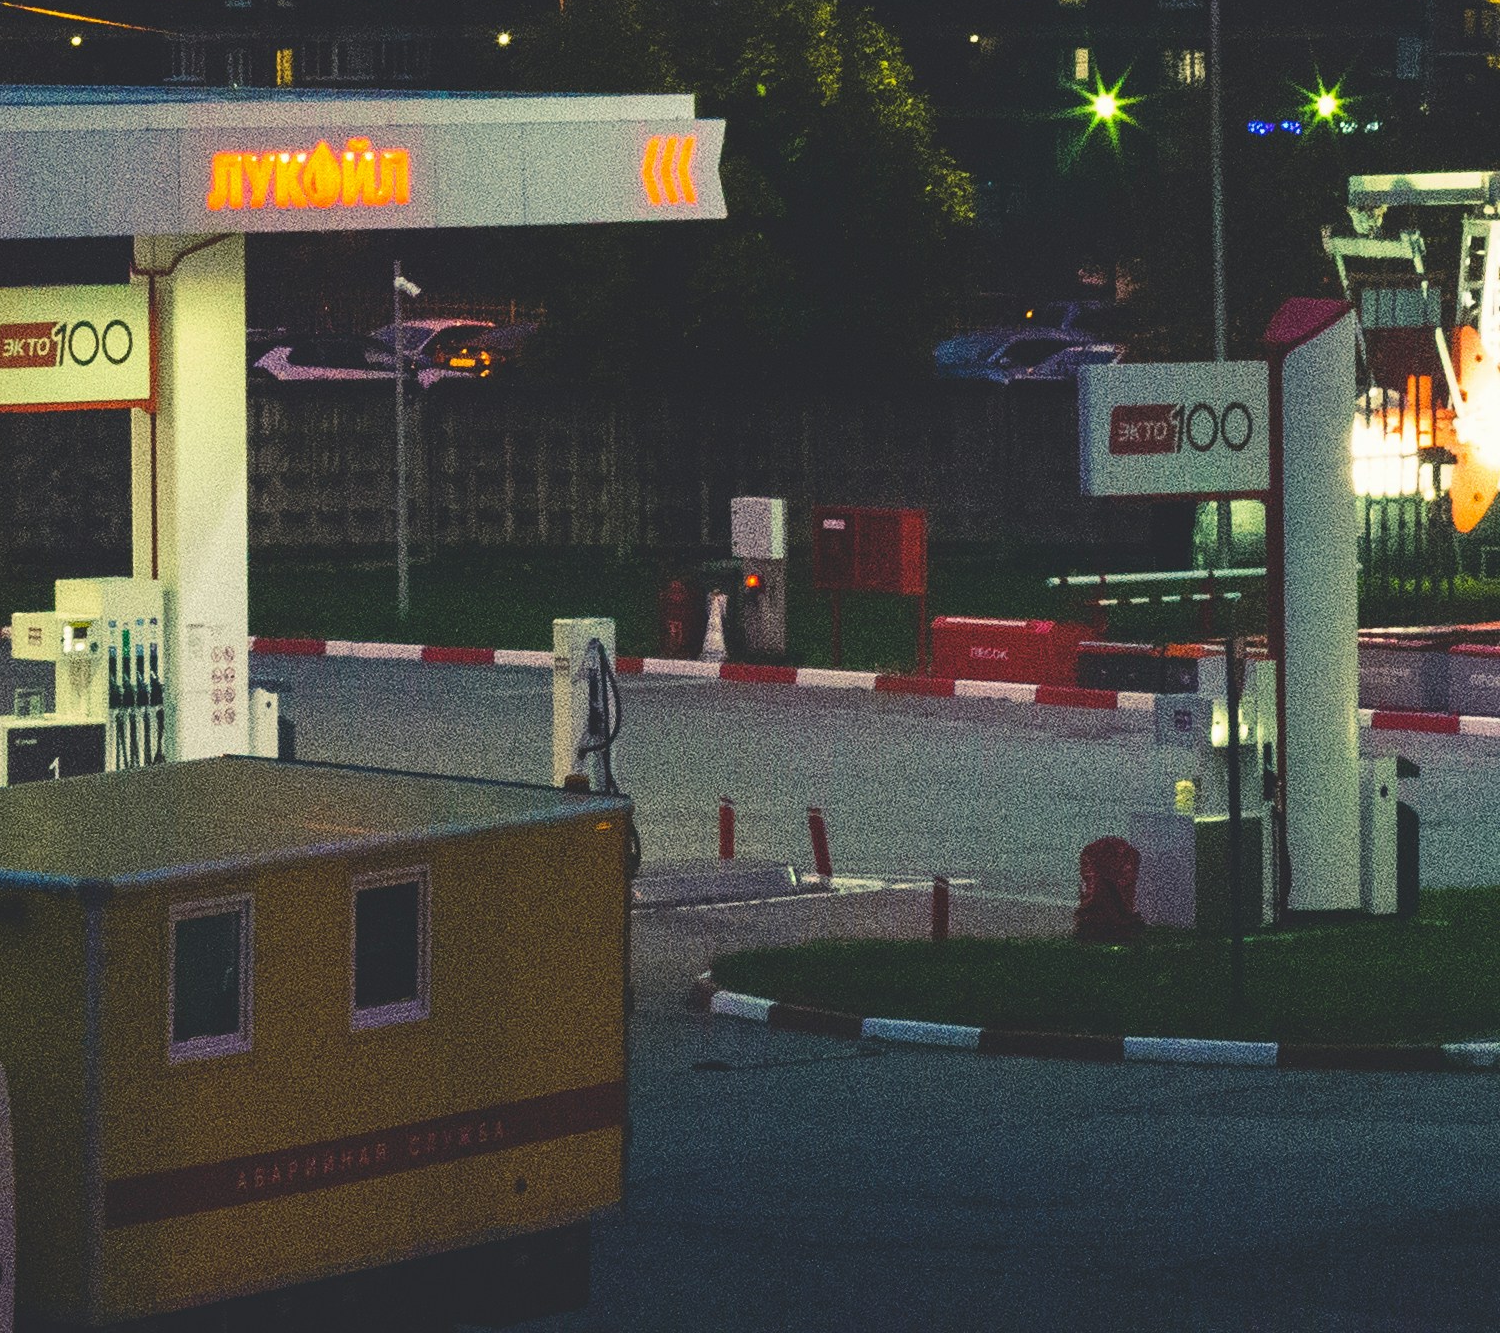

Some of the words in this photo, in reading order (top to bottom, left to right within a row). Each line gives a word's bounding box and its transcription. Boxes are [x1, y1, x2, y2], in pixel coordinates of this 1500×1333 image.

[1, 336, 51, 358] ЭКТО
[52, 320, 134, 367] 100
[1117, 421, 1169, 443] ЭКТО
[1171, 401, 1254, 452] 100
[48, 755, 60, 780] 1
